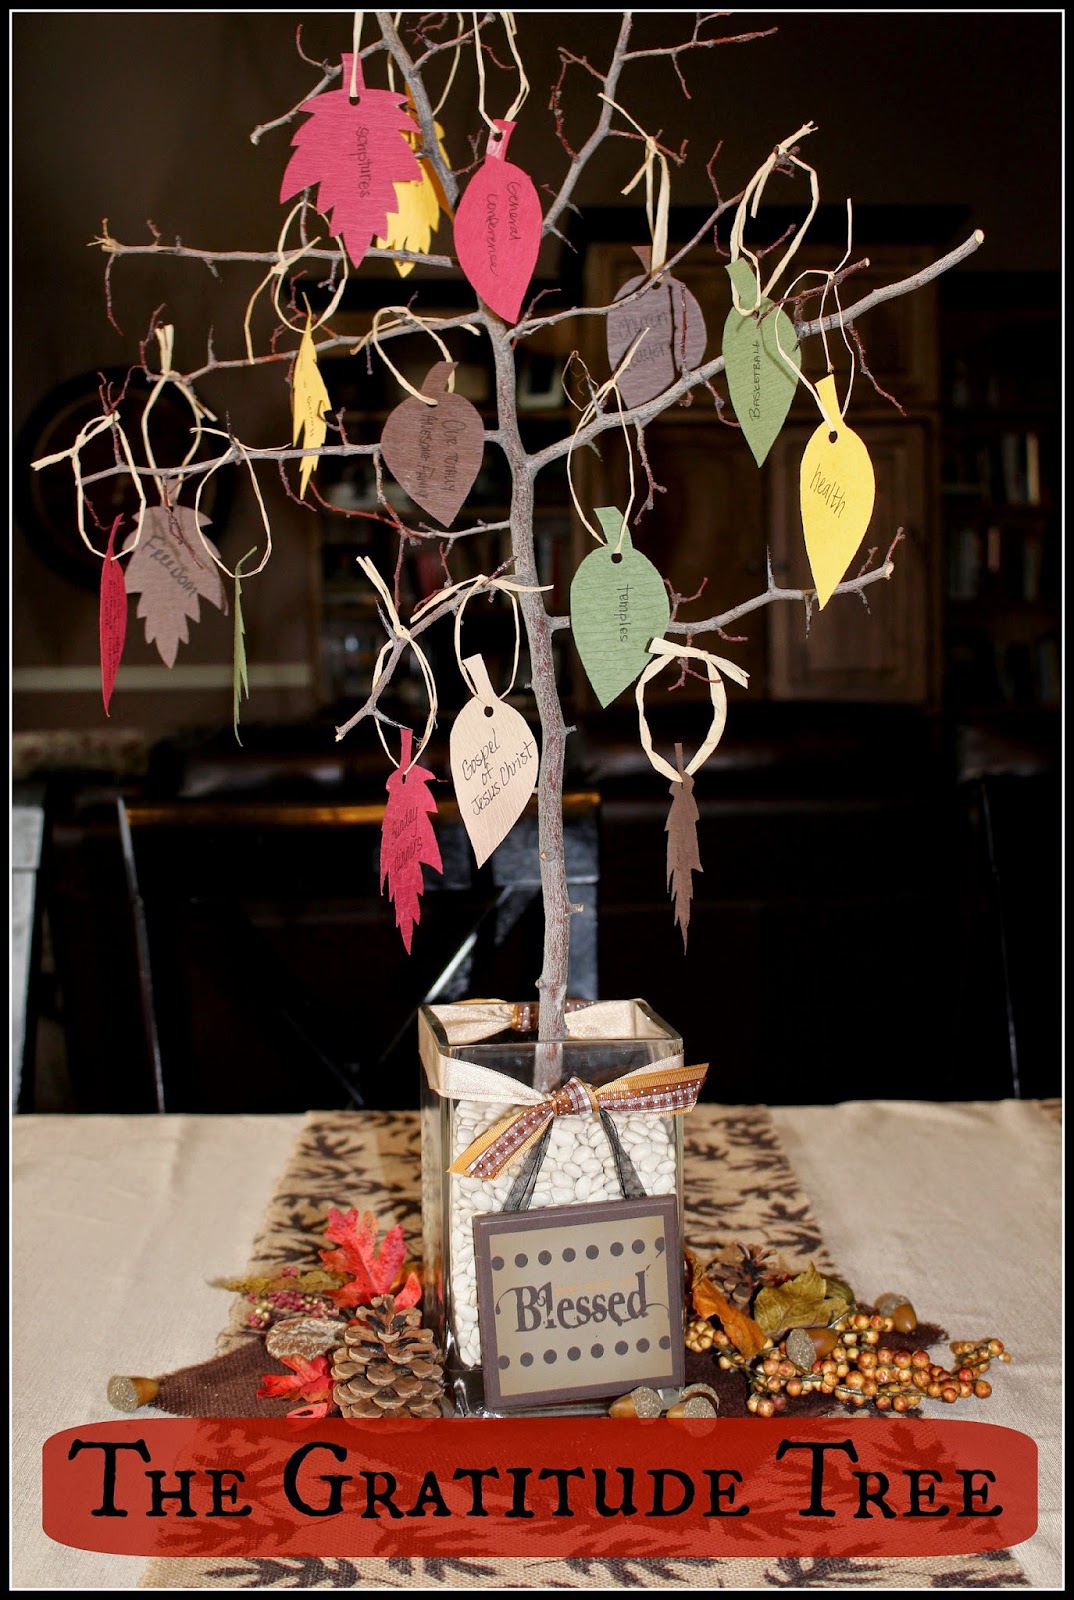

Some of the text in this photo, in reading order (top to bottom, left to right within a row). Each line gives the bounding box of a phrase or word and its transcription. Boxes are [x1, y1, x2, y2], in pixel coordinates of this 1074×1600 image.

[507, 181, 521, 241] General
[809, 462, 846, 519] health
[613, 583, 634, 642] temples
[461, 727, 501, 781] Gospel
[470, 740, 534, 816] Jesus Christ
[481, 762, 494, 786] of
[495, 1266, 670, 1333] Blessed
